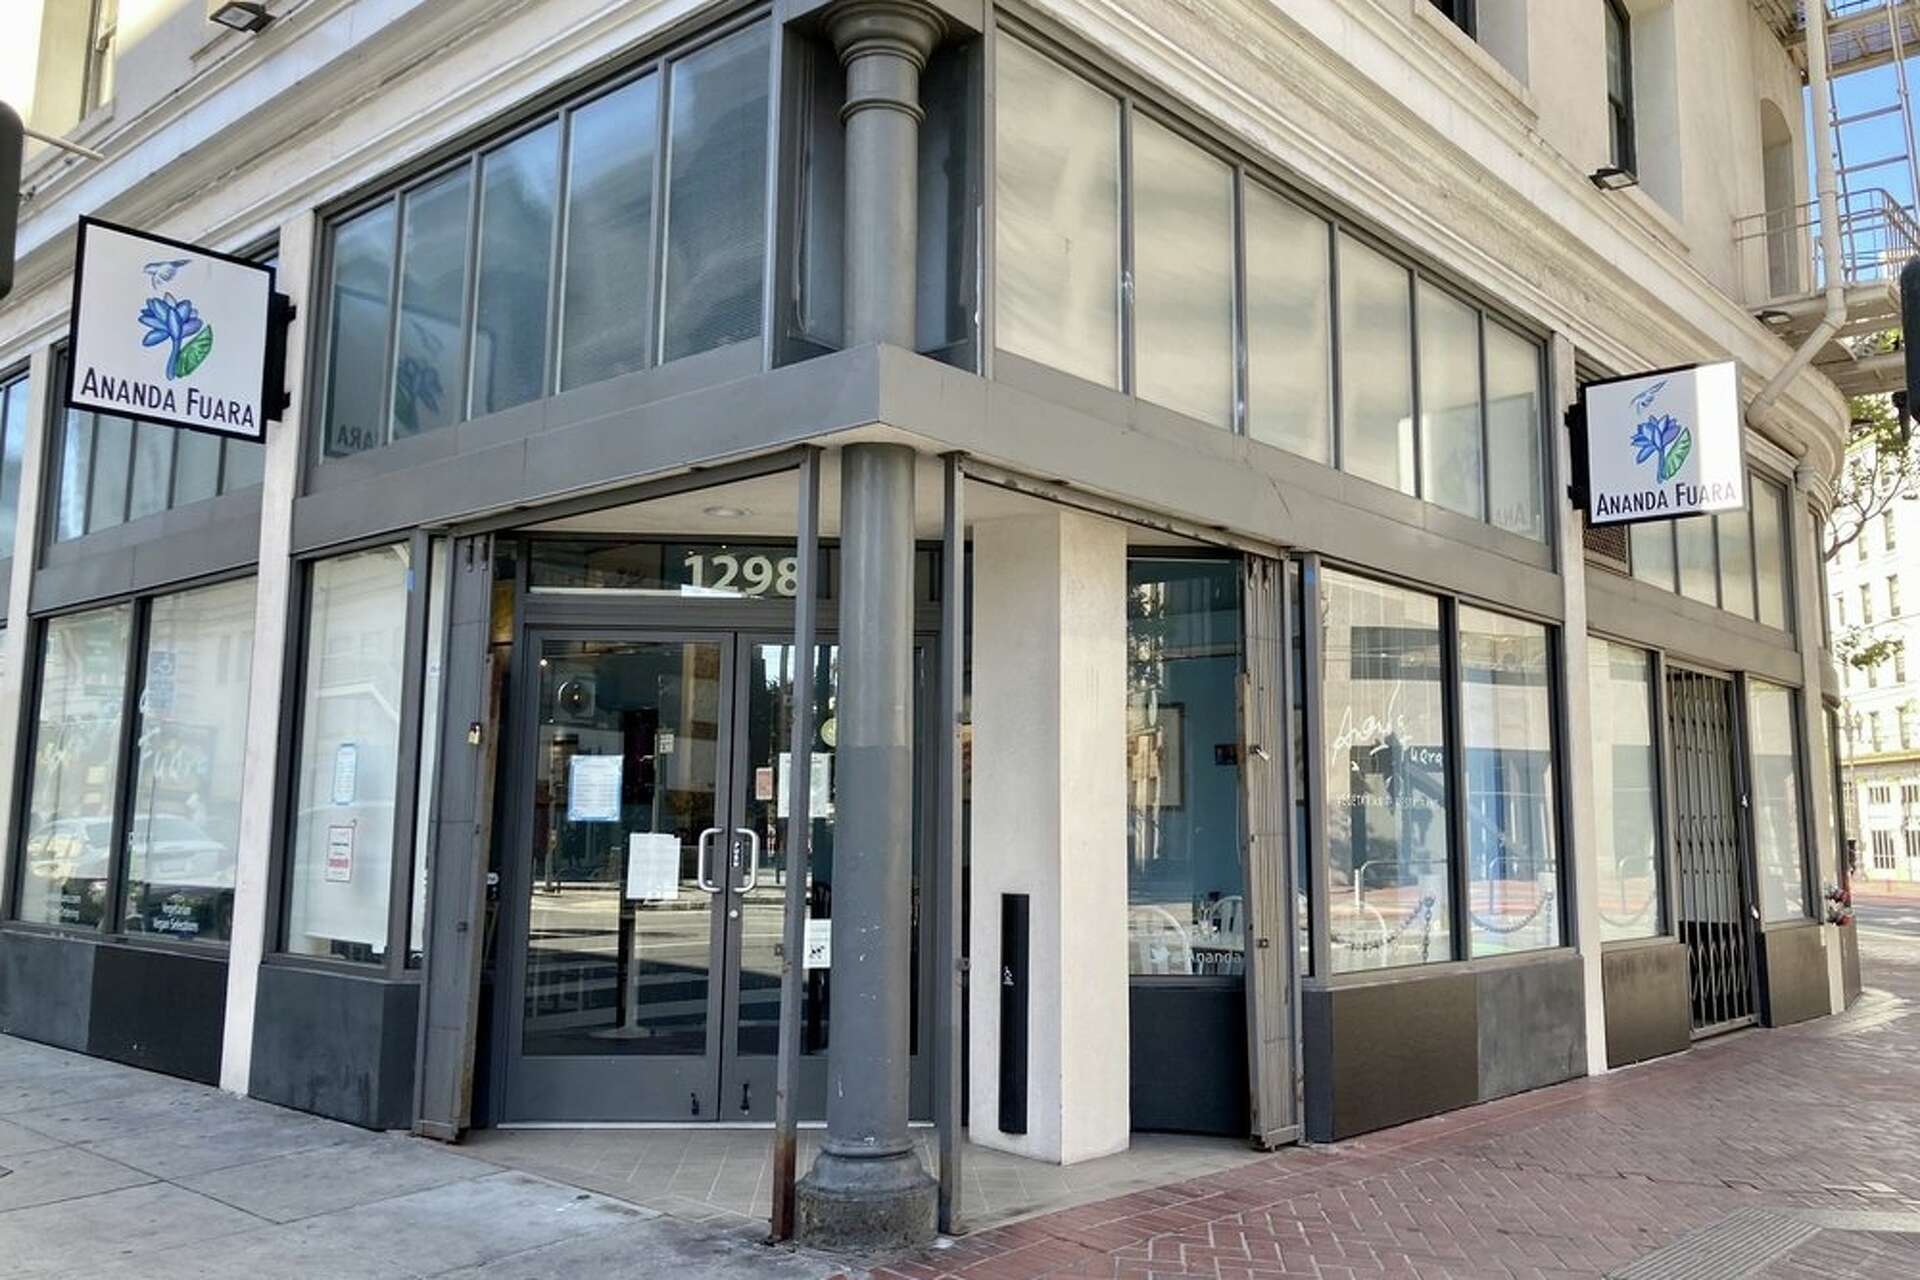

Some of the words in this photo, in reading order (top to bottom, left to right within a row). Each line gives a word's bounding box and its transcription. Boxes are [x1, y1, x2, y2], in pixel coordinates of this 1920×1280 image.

[80, 367, 177, 413] ANANDA
[186, 387, 255, 428] FUARA
[1596, 489, 1669, 517] ANANDA
[1675, 482, 1736, 507] FUARA
[684, 554, 798, 597] 1298
